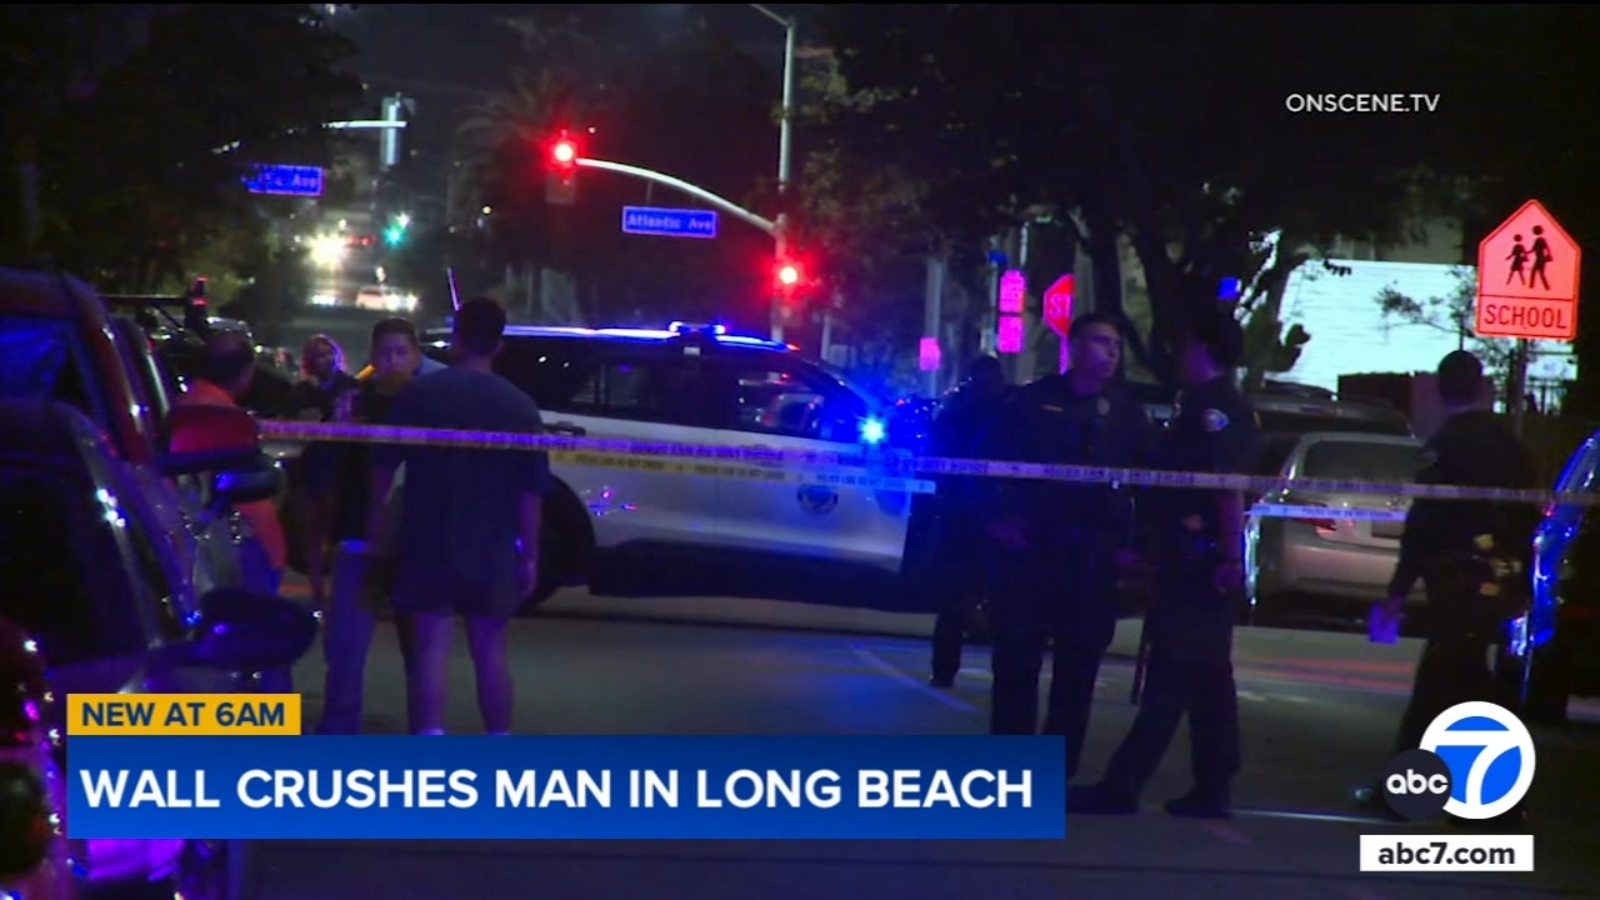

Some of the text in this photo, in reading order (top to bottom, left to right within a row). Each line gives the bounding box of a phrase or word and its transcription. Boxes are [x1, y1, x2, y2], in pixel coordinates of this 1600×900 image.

[627, 212, 712, 232] Atlantic Ave
[1049, 294, 1071, 319] ST
[1484, 303, 1568, 330] SCHOOL
